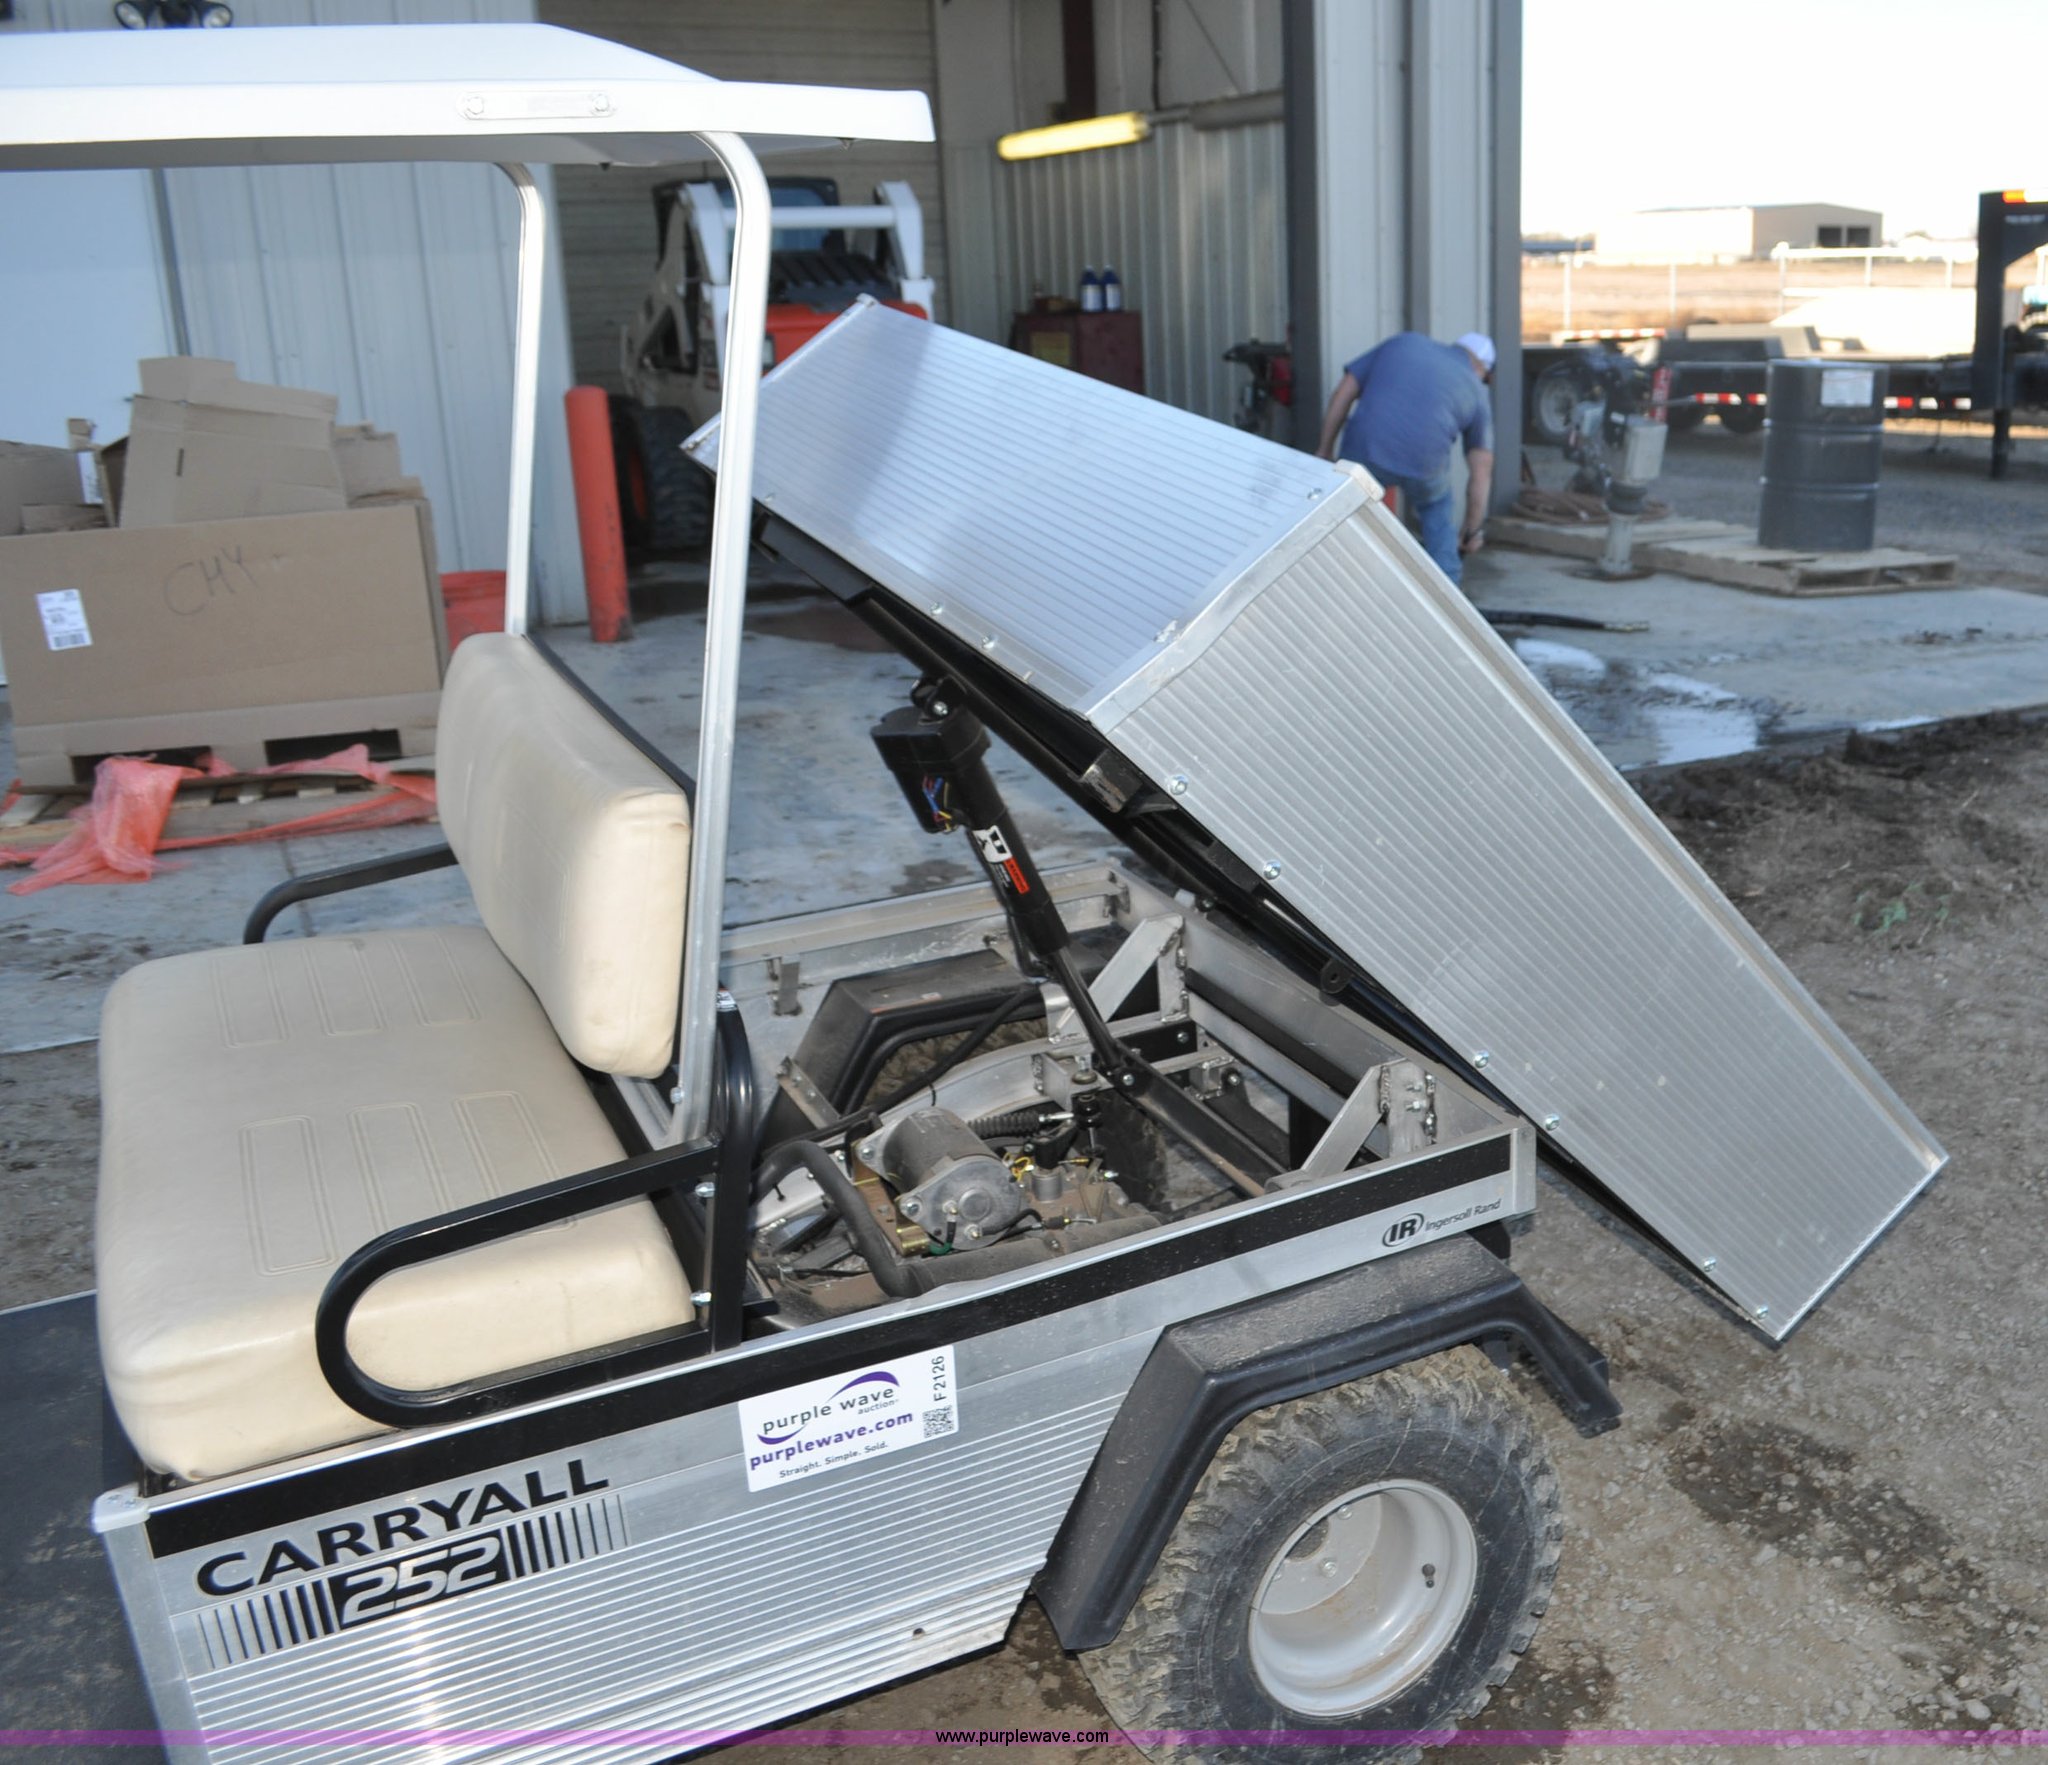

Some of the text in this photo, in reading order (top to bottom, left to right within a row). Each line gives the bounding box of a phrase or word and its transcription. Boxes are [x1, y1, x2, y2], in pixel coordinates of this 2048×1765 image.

[1388, 1218, 1417, 1243] IR
[1425, 1198, 1501, 1231] Ingersoll Rand
[931, 1355, 947, 1402] F2126
[763, 1388, 894, 1435] purple wave
[857, 1399, 896, 1415] auction
[750, 1412, 913, 1471] purplewave.com
[779, 1441, 888, 1479] Straight. Simple. Sold.
[196, 1459, 609, 1597] CARRYALL
[341, 1536, 501, 1627] 252
